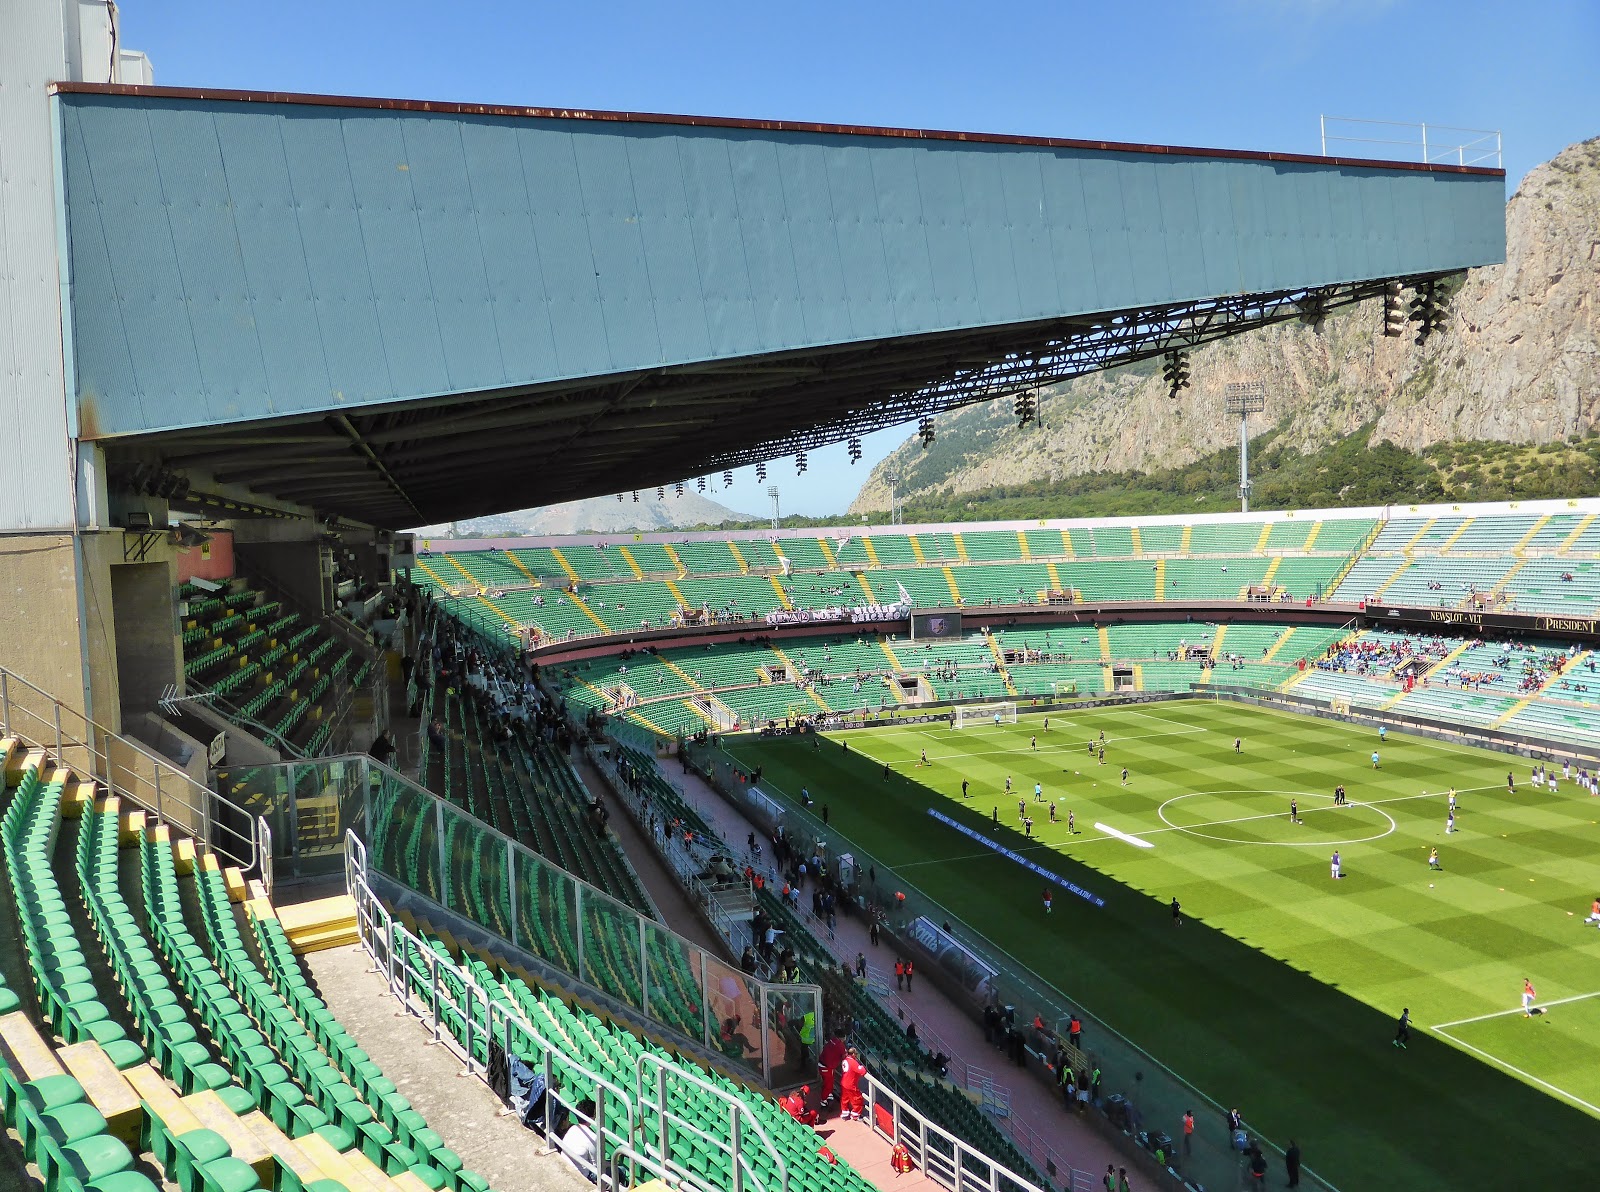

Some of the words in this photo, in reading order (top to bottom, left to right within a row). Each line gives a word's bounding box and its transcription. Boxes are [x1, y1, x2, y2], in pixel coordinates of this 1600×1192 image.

[1430, 611, 1463, 623] NEWSLOT
[1469, 614, 1482, 624] VLT
[1545, 617, 1597, 634] PRESIDENT
